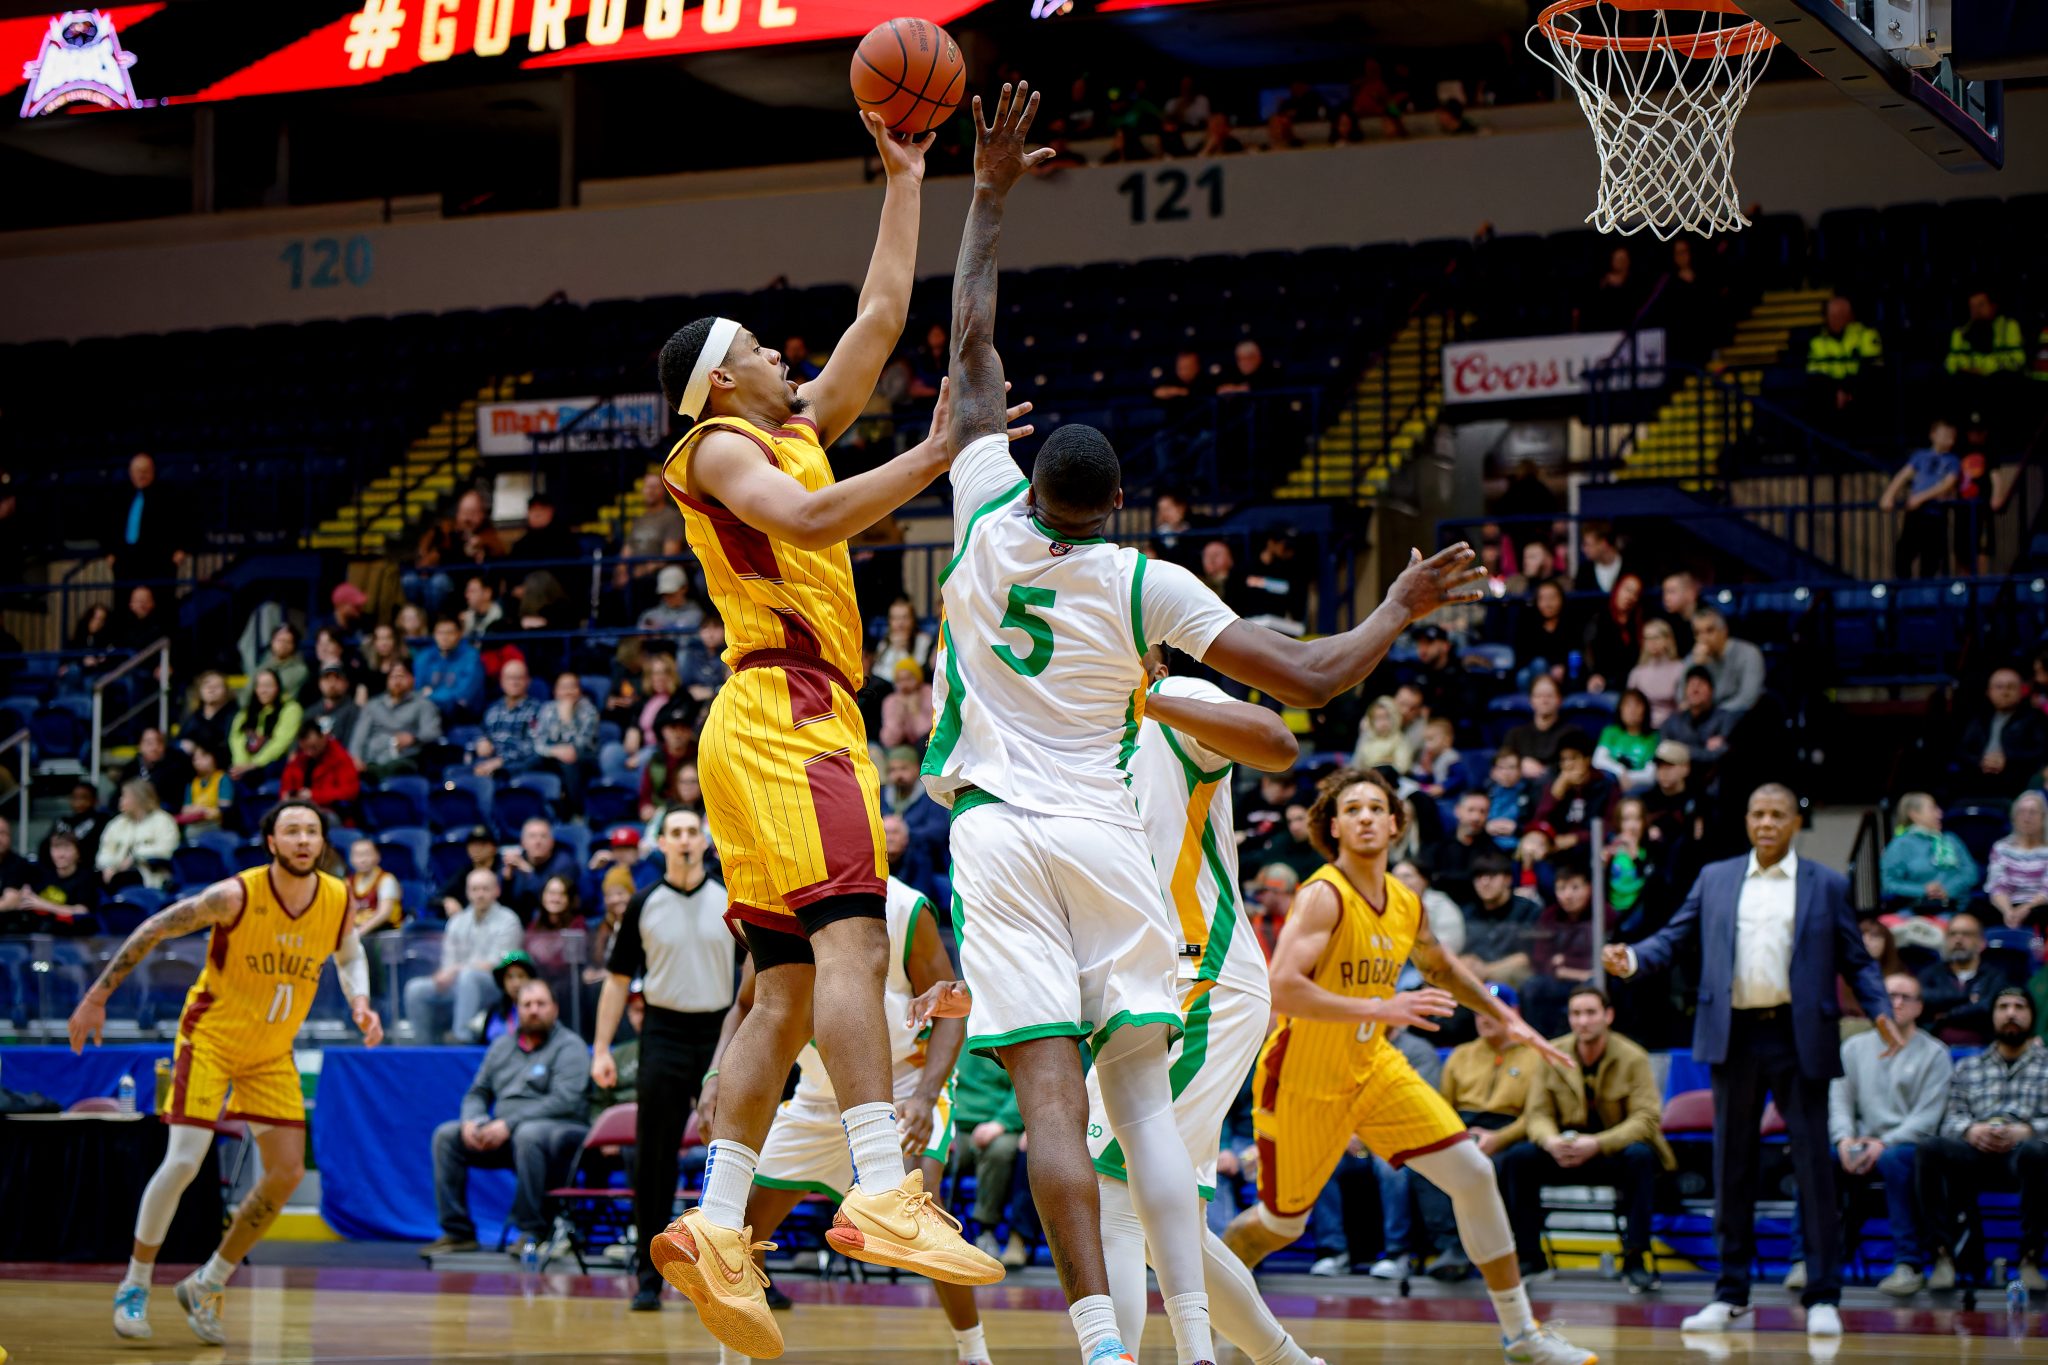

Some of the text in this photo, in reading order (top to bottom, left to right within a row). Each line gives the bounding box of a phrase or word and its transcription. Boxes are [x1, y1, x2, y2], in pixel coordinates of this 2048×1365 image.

[1117, 166, 1224, 223] 121
[279, 235, 375, 289] 120
[1452, 351, 1560, 395] Coors
[990, 583, 1057, 677] 5
[267, 983, 294, 1024] 11
